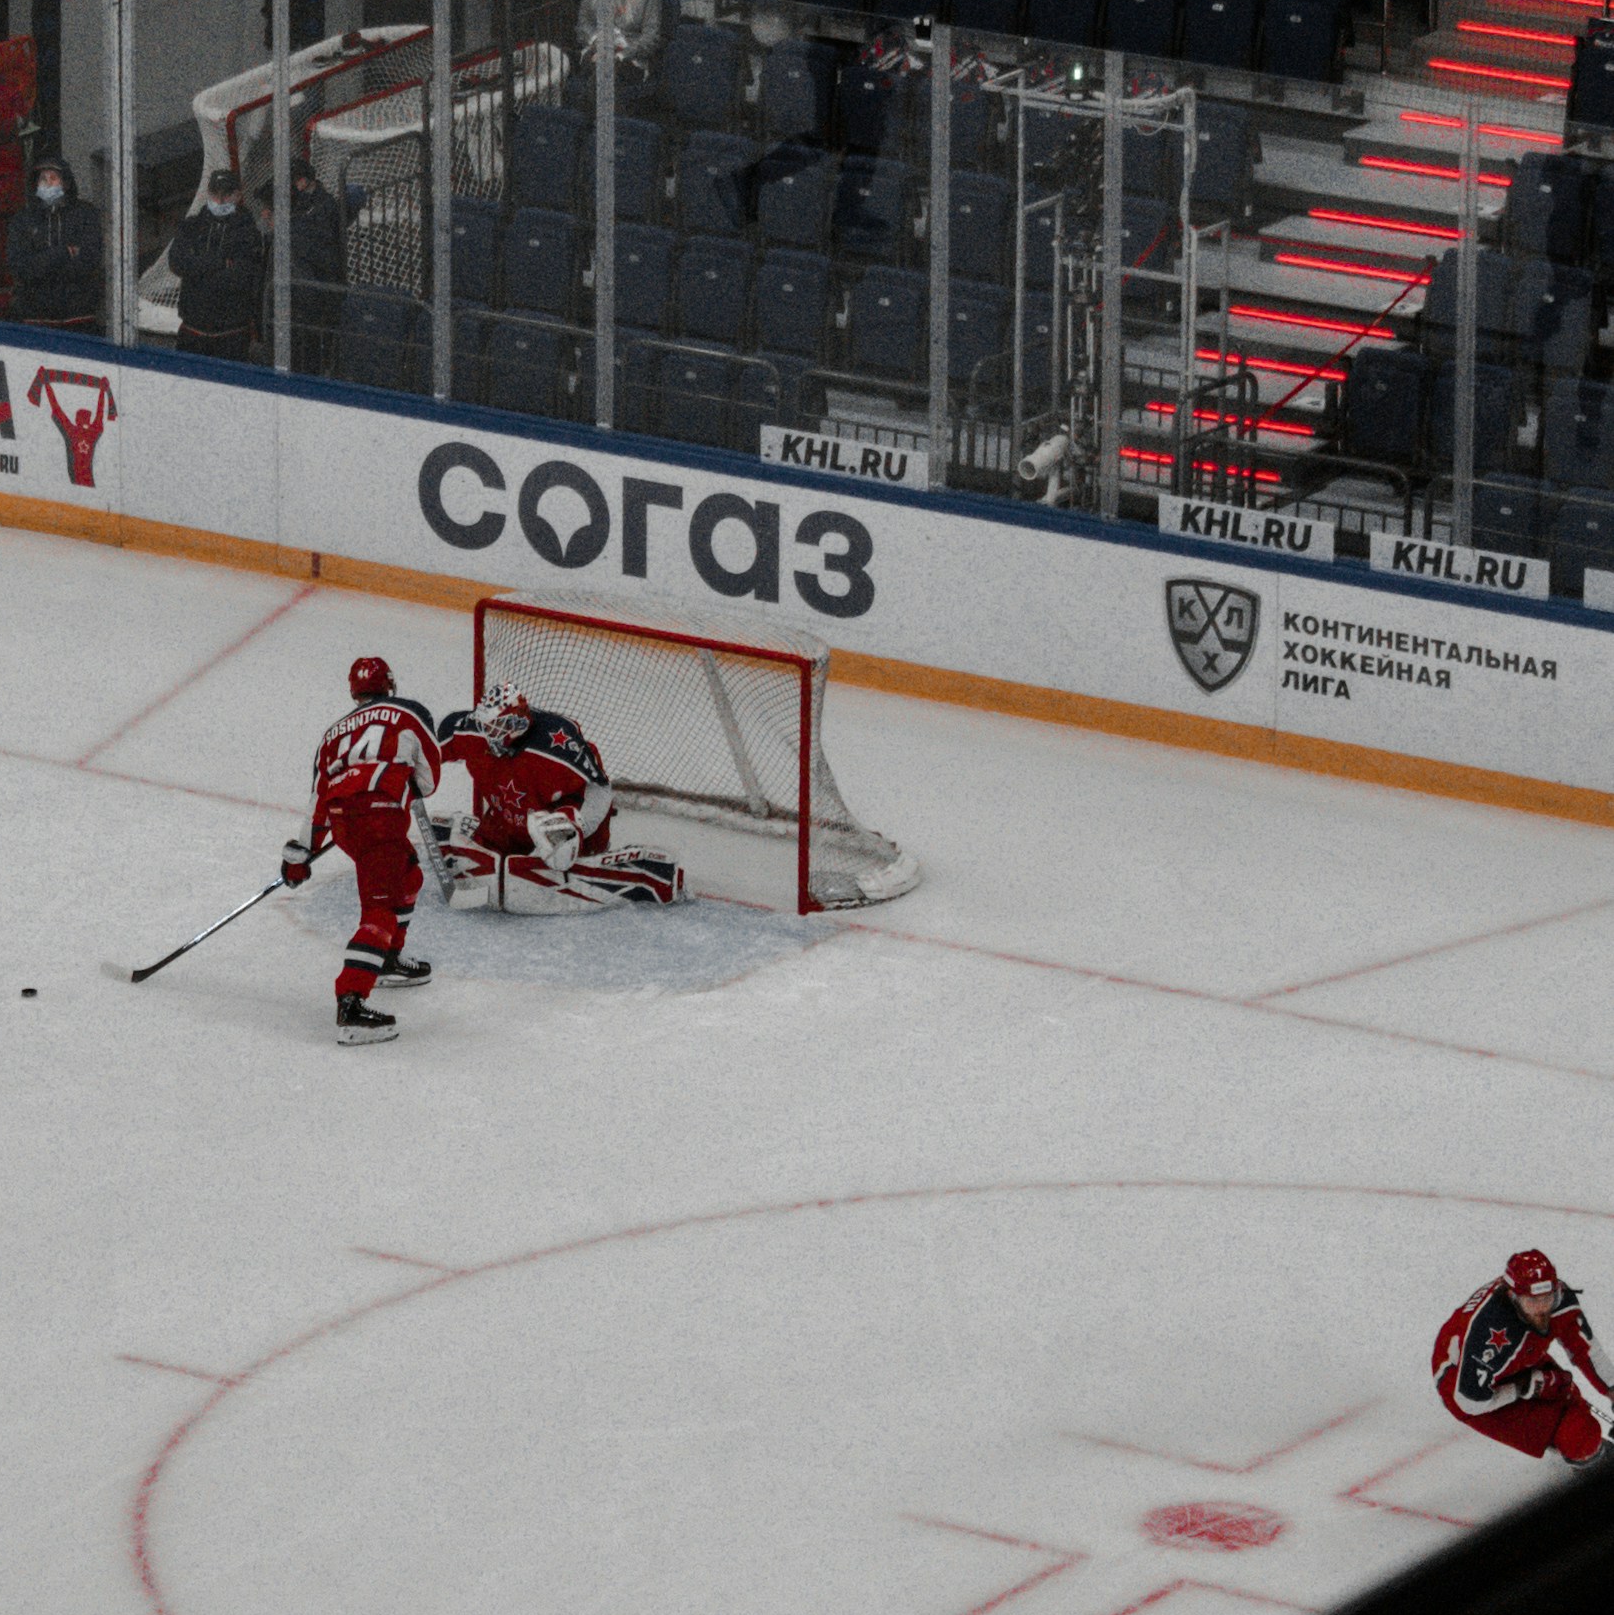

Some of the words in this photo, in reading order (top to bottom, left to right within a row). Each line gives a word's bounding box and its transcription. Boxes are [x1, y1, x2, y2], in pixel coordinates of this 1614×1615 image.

[781, 432, 908, 482] KHL.RU
[1180, 503, 1313, 554] KHL.RU
[1391, 540, 1528, 591] KHL.RU
[1282, 639, 1452, 690] ХОККЕЙНАЯ
[1283, 611, 1558, 680] КОНТИНЕНТАЛЬНАЯ
[1281, 671, 1351, 700] ЛИГА
[325, 708, 402, 744] SOSHNIKOV
